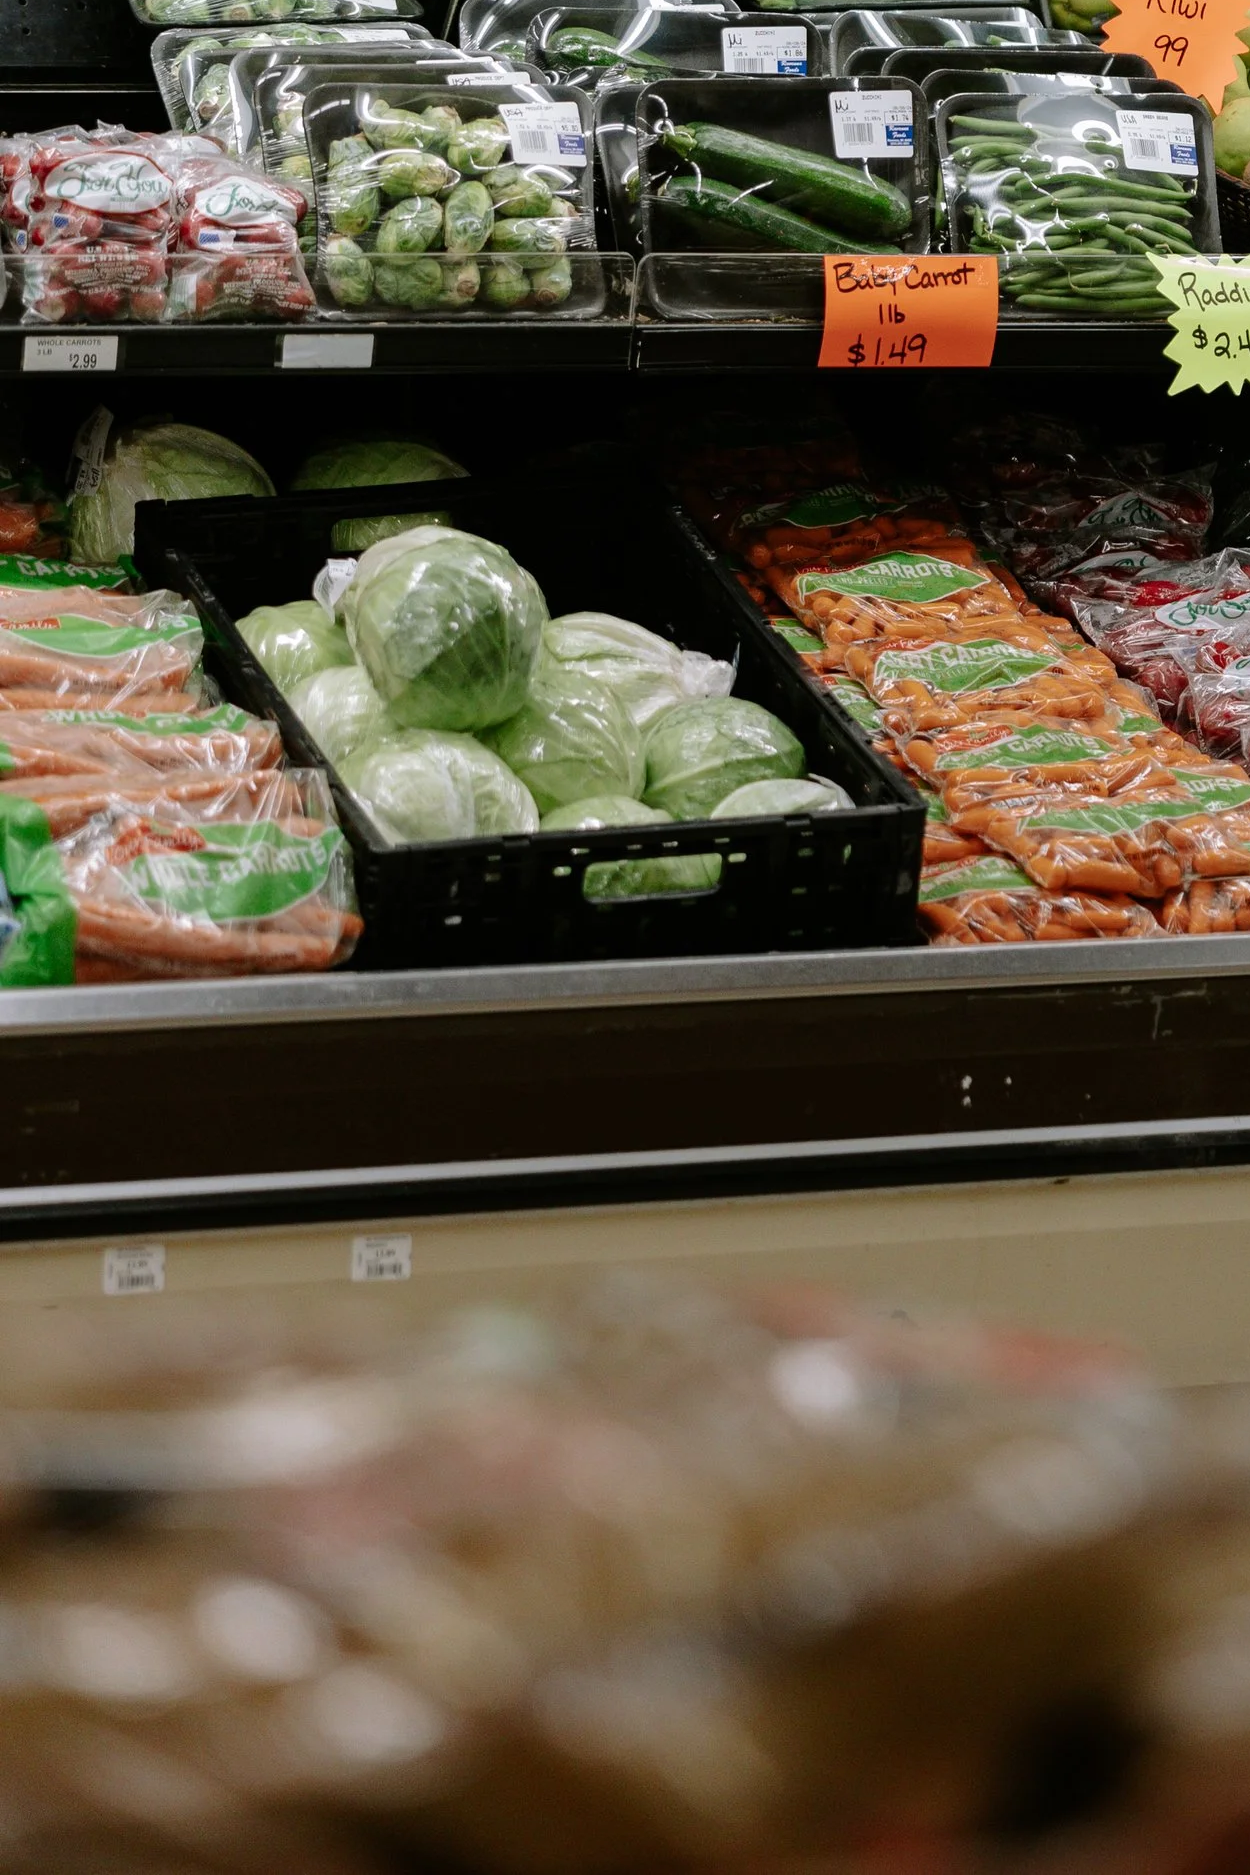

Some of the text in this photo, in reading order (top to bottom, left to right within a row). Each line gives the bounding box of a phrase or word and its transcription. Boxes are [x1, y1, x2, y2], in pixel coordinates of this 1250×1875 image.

[1154, 34, 1189, 67] 99
[904, 262, 976, 290] Carrot
[37, 338, 101, 347] WHOLE CARROTS
[848, 333, 928, 367] $1.49
[69, 353, 98, 369] $2.99
[862, 561, 955, 580] CARROTS
